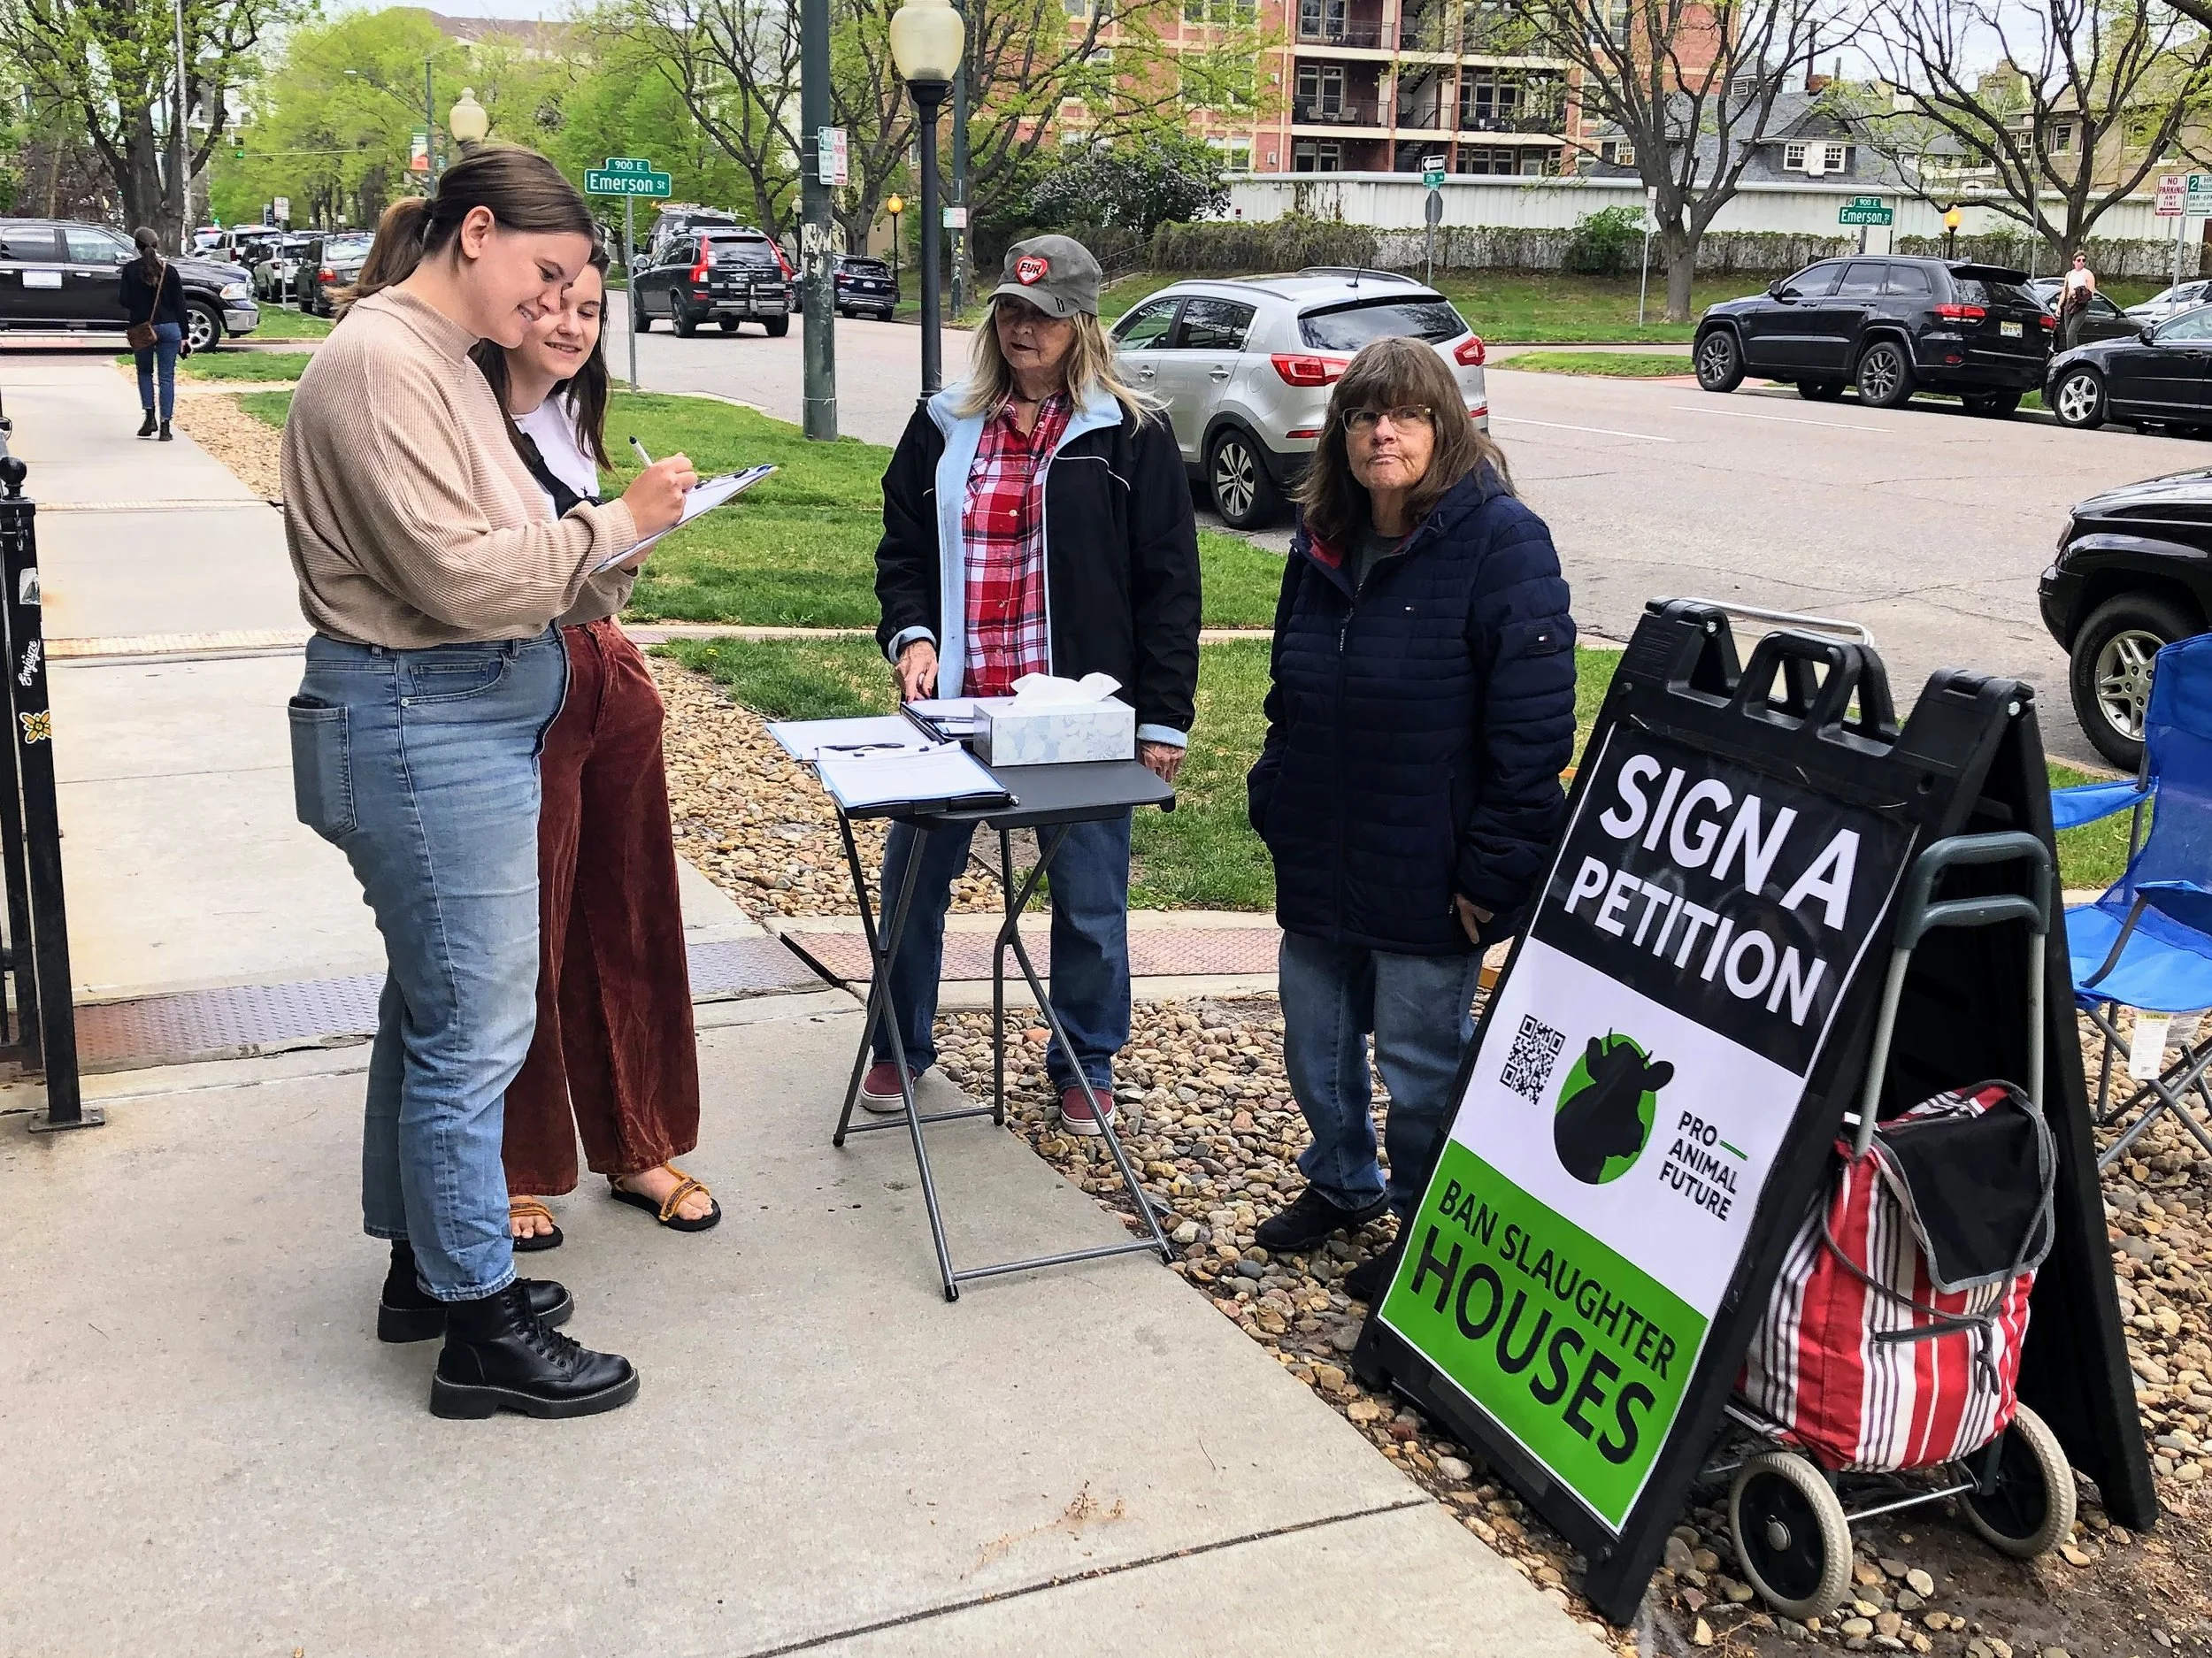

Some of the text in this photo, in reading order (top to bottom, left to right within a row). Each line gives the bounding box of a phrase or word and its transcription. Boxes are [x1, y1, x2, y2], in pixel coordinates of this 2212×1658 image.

[589, 173, 665, 192] Emerson St
[614, 160, 643, 171] 900 E
[2190, 178, 2198, 190] 2
[1841, 209, 1882, 223] Emerson
[1599, 754, 1861, 931] SIGN A
[1563, 856, 1828, 1027] PETITION
[1677, 1109, 1718, 1147] PRO
[1657, 1159, 1733, 1222] FUTURE
[1668, 1137, 1739, 1195] ANIMAL
[1437, 1178, 1677, 1381] BAN SLAUGHTER
[1409, 1224, 1657, 1465] HOUSES
